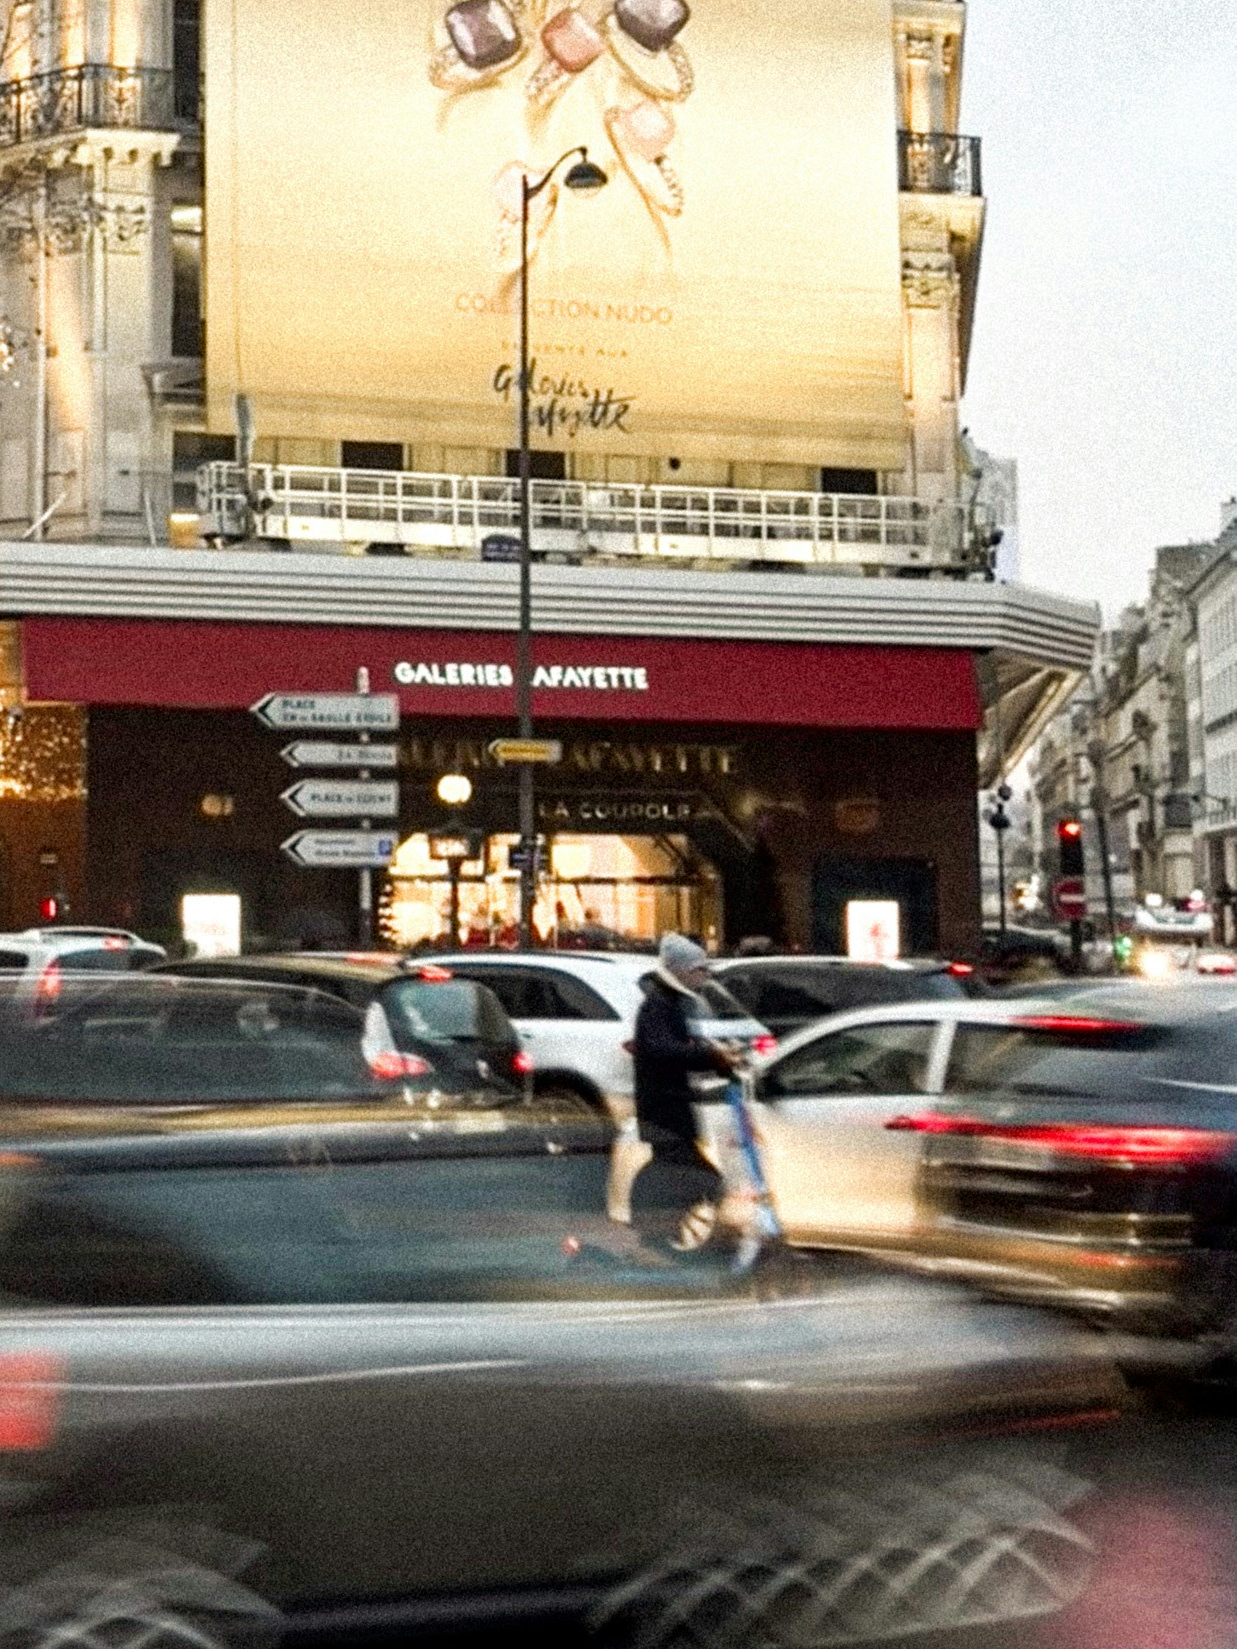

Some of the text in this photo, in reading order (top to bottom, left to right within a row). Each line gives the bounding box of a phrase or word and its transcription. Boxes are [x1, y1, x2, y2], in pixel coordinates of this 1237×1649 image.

[455, 292, 674, 325] COLLCTION NUDO
[493, 356, 590, 403] Gleries
[394, 661, 649, 690] GALERIES AFAYETTE
